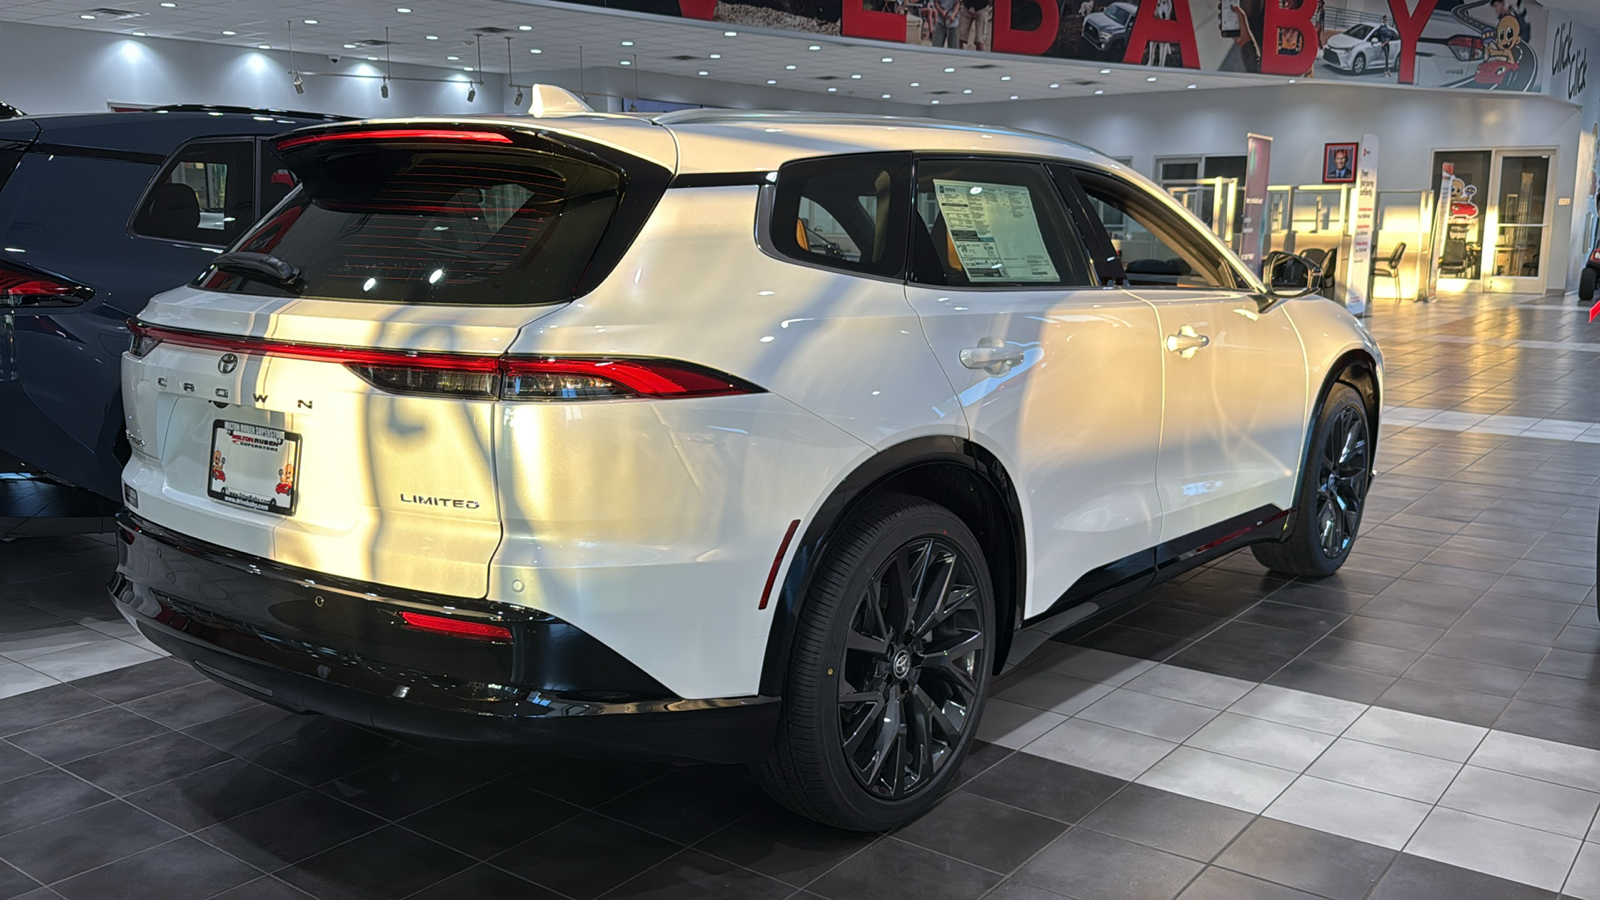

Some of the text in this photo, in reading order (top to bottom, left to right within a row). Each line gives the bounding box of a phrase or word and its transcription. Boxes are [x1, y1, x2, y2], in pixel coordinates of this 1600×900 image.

[1552, 20, 1573, 76] Click
[1568, 47, 1588, 100] Click
[157, 377, 313, 410] CROWN
[254, 437, 279, 447] RUBEN
[400, 493, 480, 510] LIMITED
